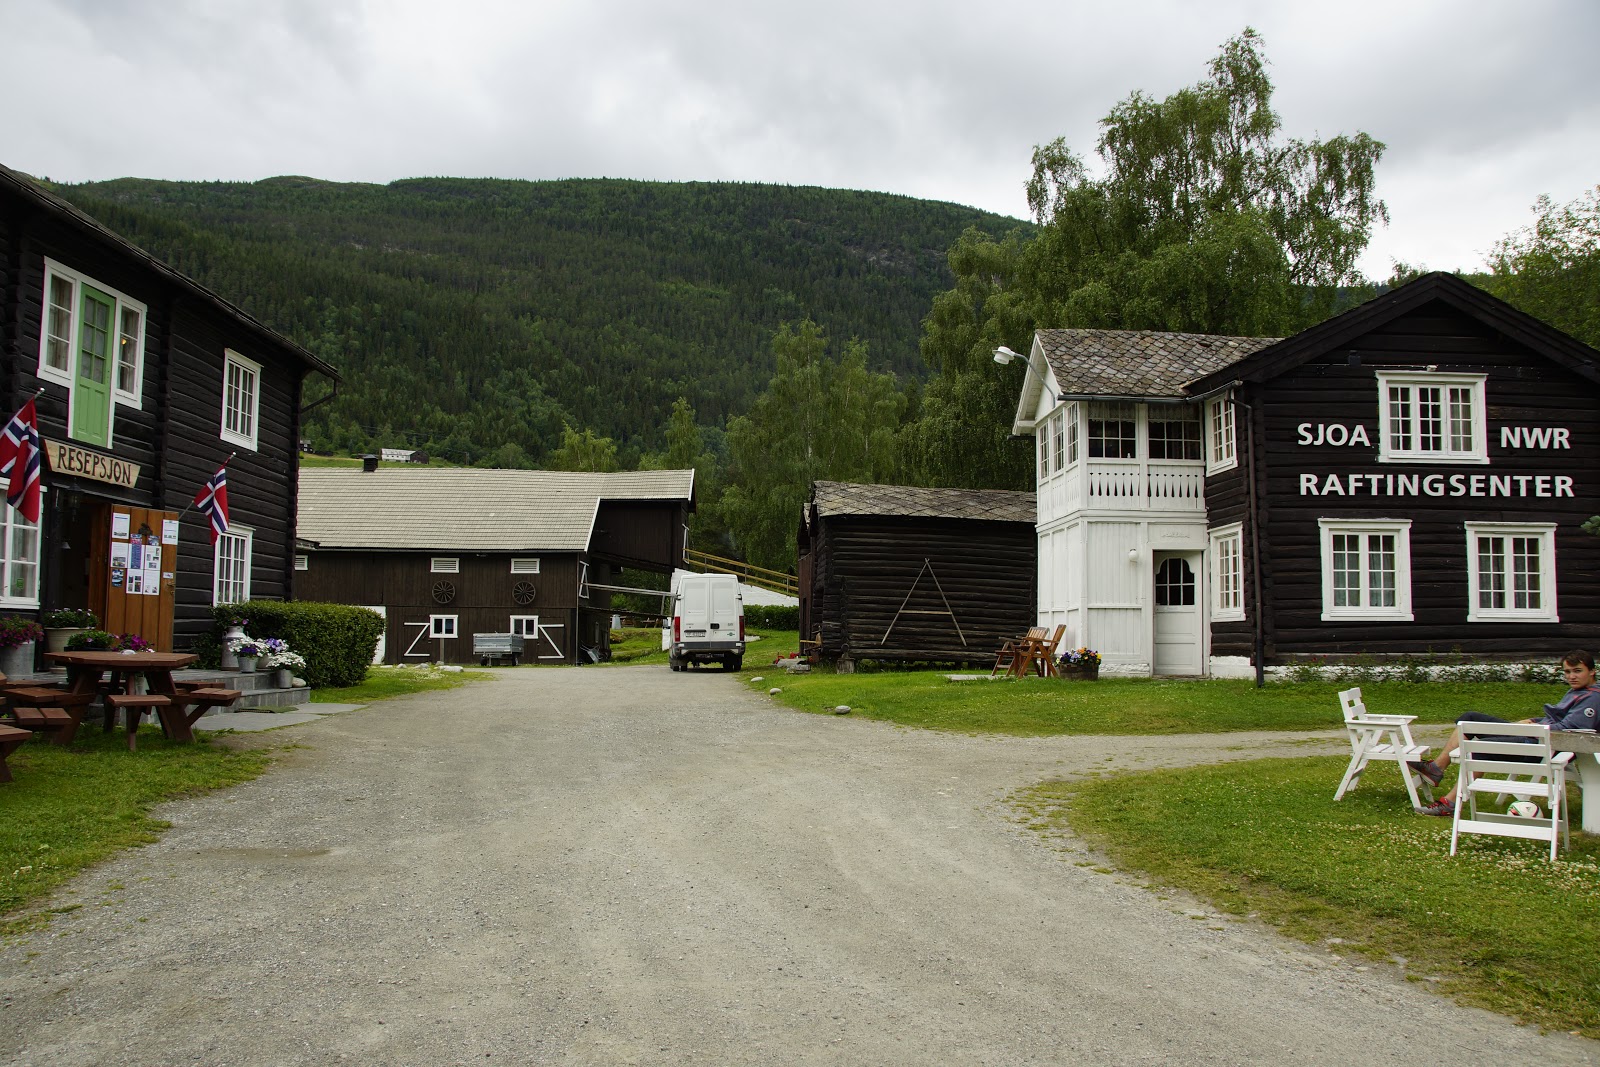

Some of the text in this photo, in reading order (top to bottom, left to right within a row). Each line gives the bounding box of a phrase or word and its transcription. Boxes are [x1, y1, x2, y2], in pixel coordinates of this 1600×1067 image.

[1297, 423, 1570, 449] SJOA NWR
[57, 446, 131, 484] RESEPSJON
[1299, 474, 1575, 497] RAFTINGSENTER
